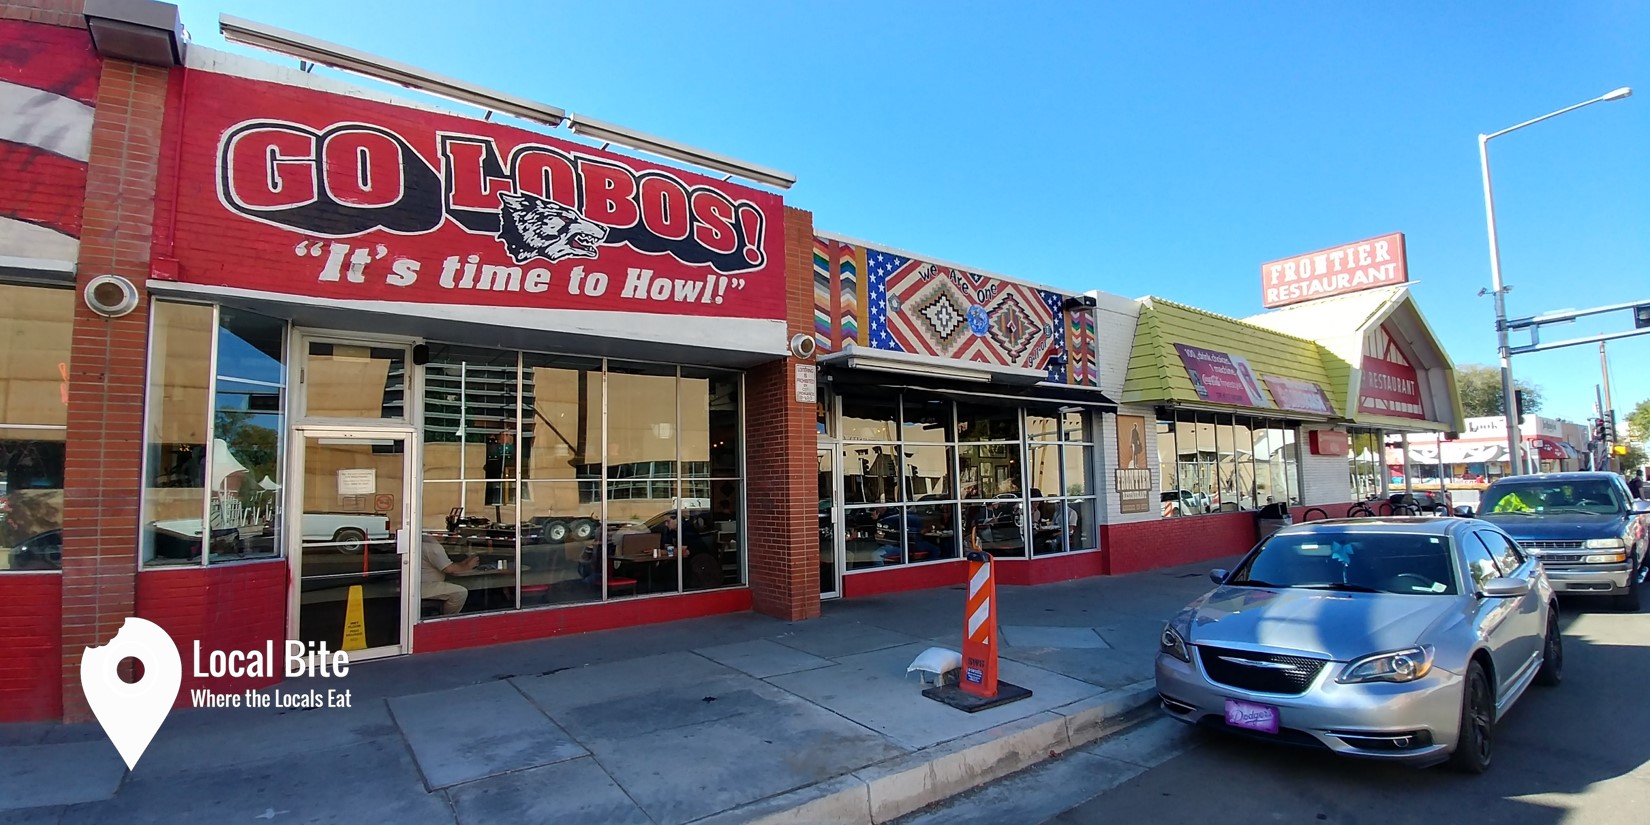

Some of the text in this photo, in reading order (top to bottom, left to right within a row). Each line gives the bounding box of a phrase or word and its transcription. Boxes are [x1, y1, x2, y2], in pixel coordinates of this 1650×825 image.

[219, 119, 766, 268] GO LOBOS!
[439, 254, 552, 294] time
[569, 264, 609, 298] to
[1267, 262, 1398, 304] RESTAURANT
[1269, 239, 1392, 285] FRONTIER
[950, 269, 969, 295] Are
[976, 283, 998, 304] One
[1368, 371, 1415, 396] RESTAURANT
[1116, 470, 1151, 491] FRONTIER
